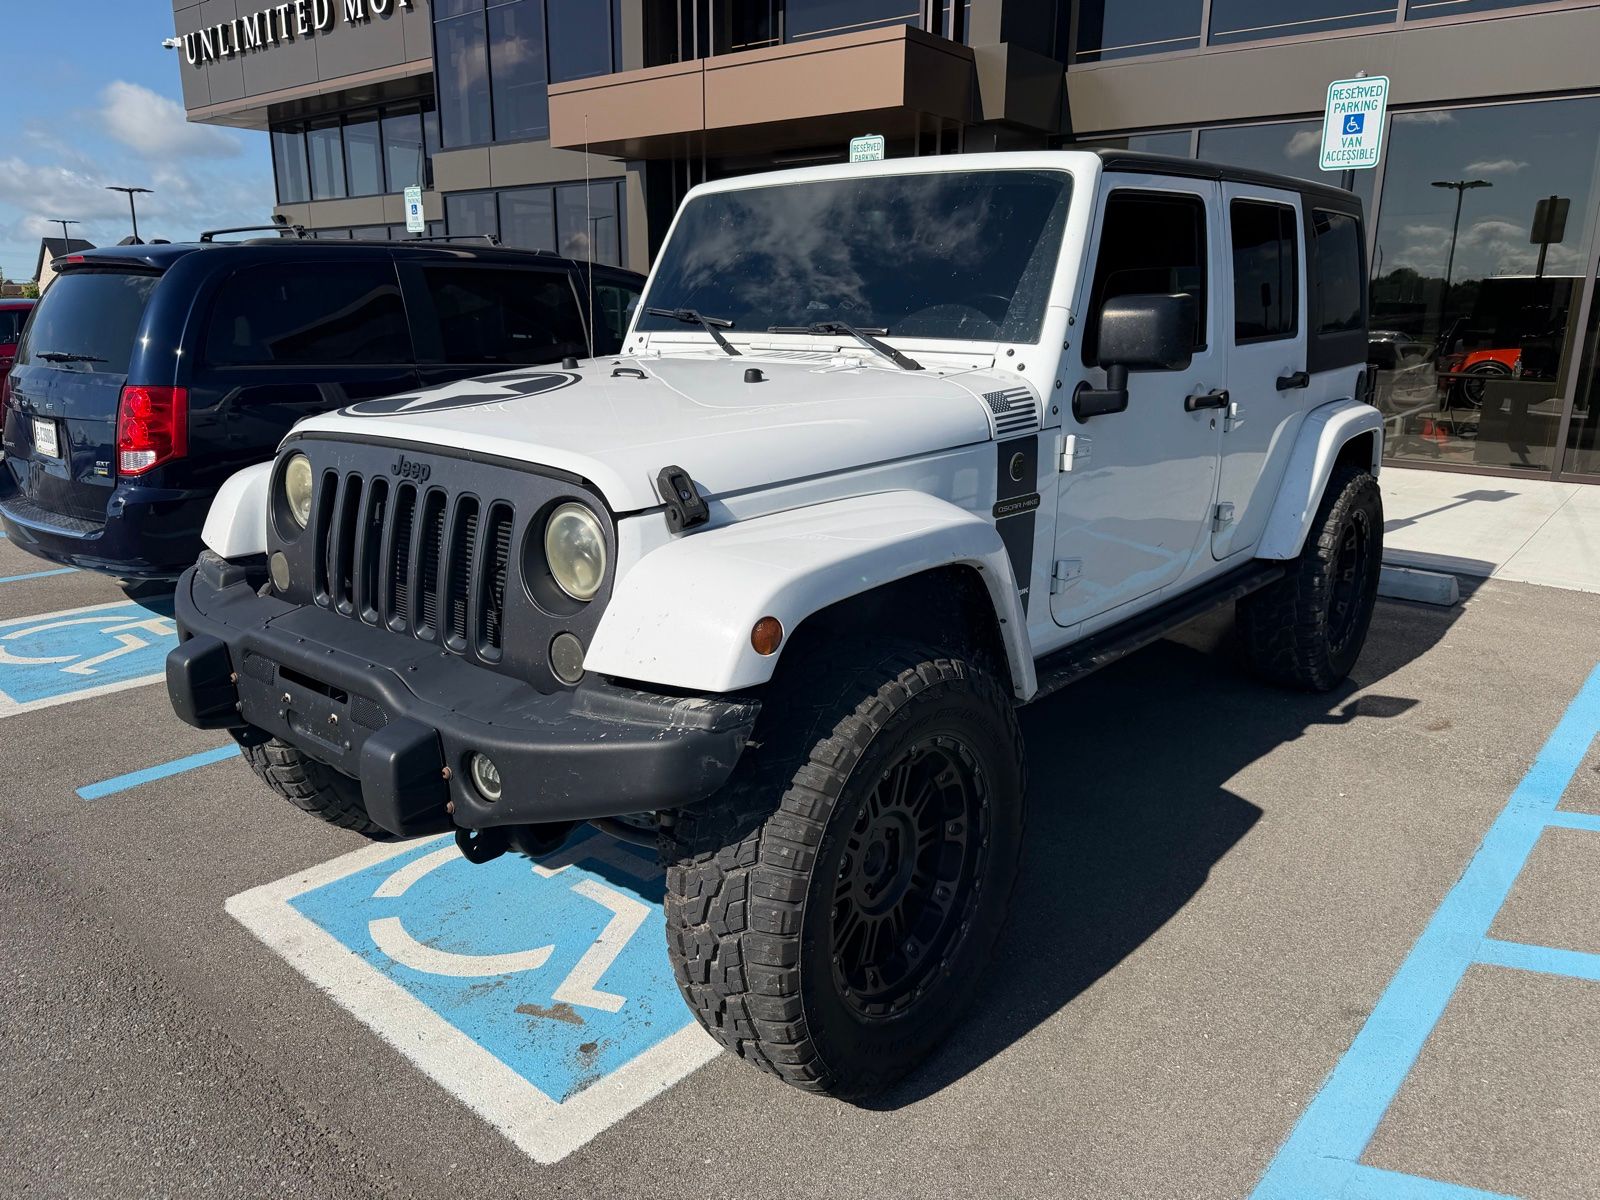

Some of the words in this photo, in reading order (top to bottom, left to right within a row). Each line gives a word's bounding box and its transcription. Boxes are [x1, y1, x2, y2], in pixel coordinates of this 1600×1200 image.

[184, 0, 328, 64] UNLIMITED
[1333, 85, 1383, 100] RESERVED
[1334, 100, 1378, 113] PARKING
[853, 143, 881, 153] RESERVED
[1341, 136, 1362, 148] VAN
[854, 153, 880, 162] PARKING
[1325, 148, 1375, 161] ACCESSIBLE
[95, 460, 110, 468] SXT
[391, 454, 431, 484] Jeep
[998, 502, 1022, 513] OSCAR
[1023, 498, 1038, 507] MIKE
